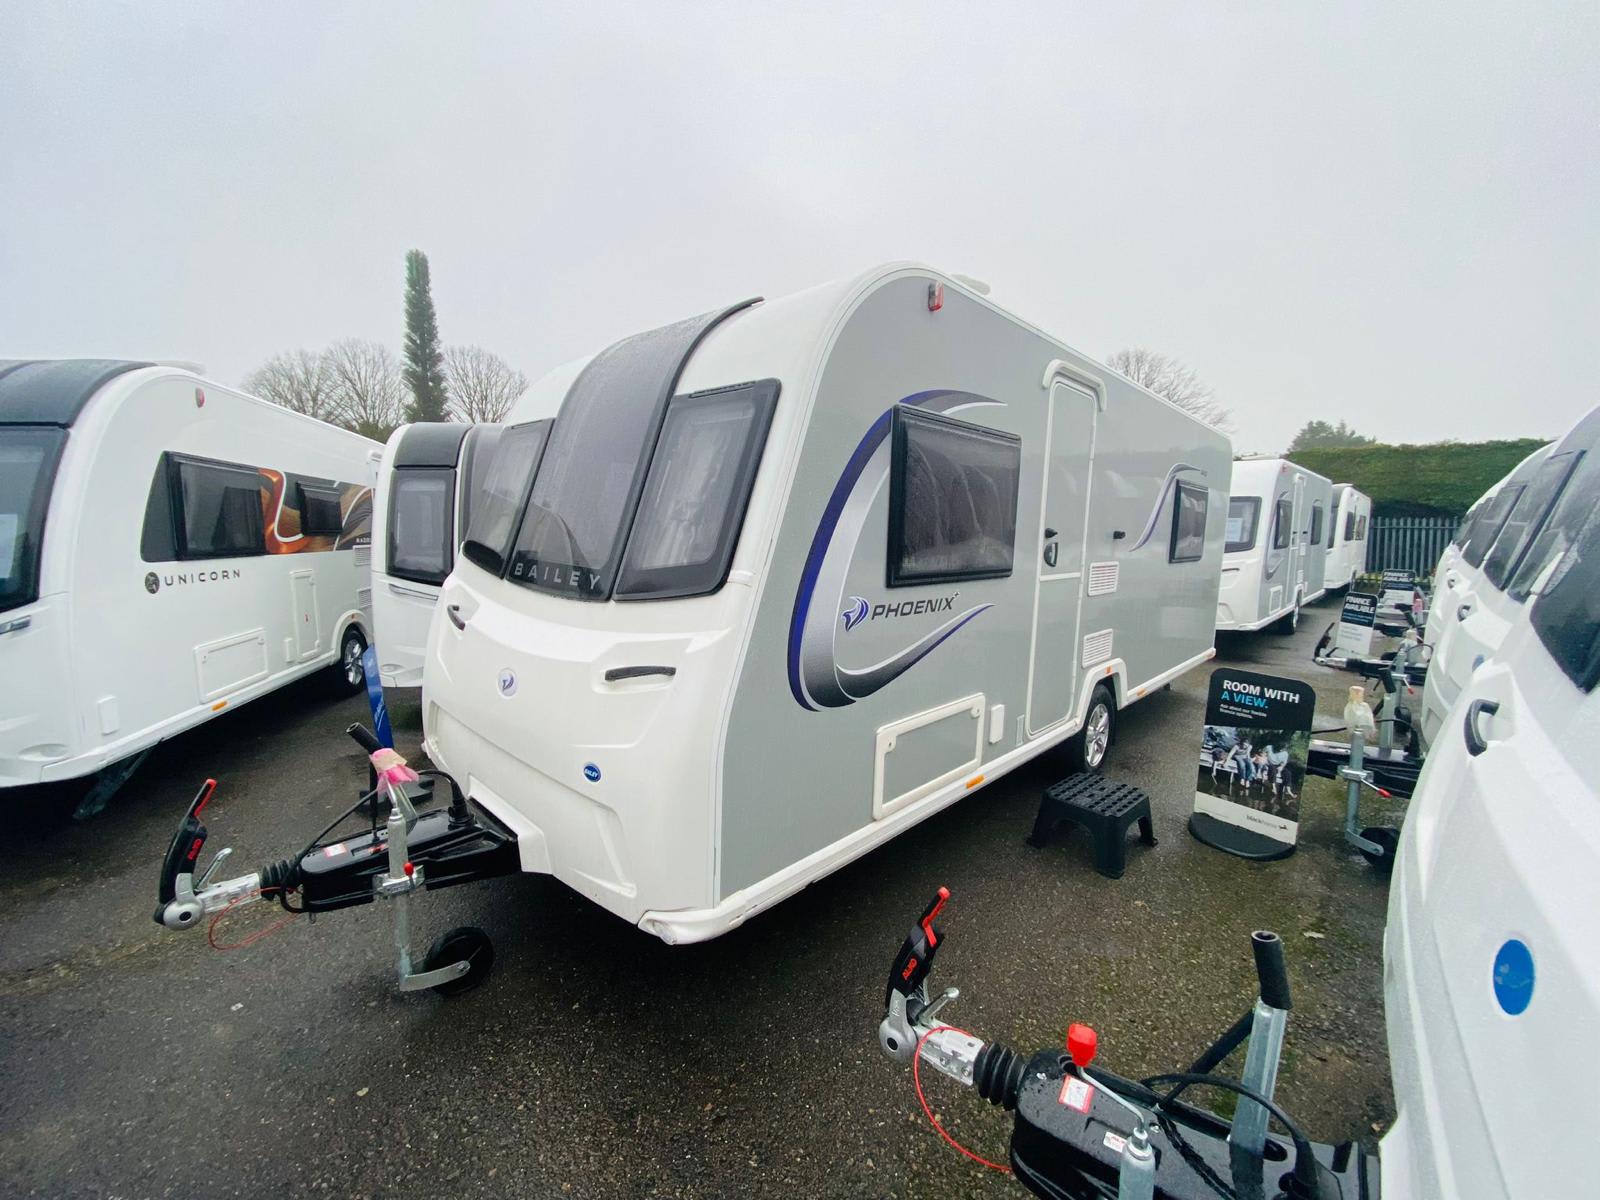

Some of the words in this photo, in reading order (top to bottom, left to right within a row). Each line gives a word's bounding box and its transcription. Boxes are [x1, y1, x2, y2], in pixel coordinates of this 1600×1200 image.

[164, 568, 241, 587] UNICORN
[514, 562, 601, 590] BAILEY
[1221, 690, 1230, 701] A
[1223, 679, 1260, 696] ROOM
[1264, 687, 1300, 704] WITH
